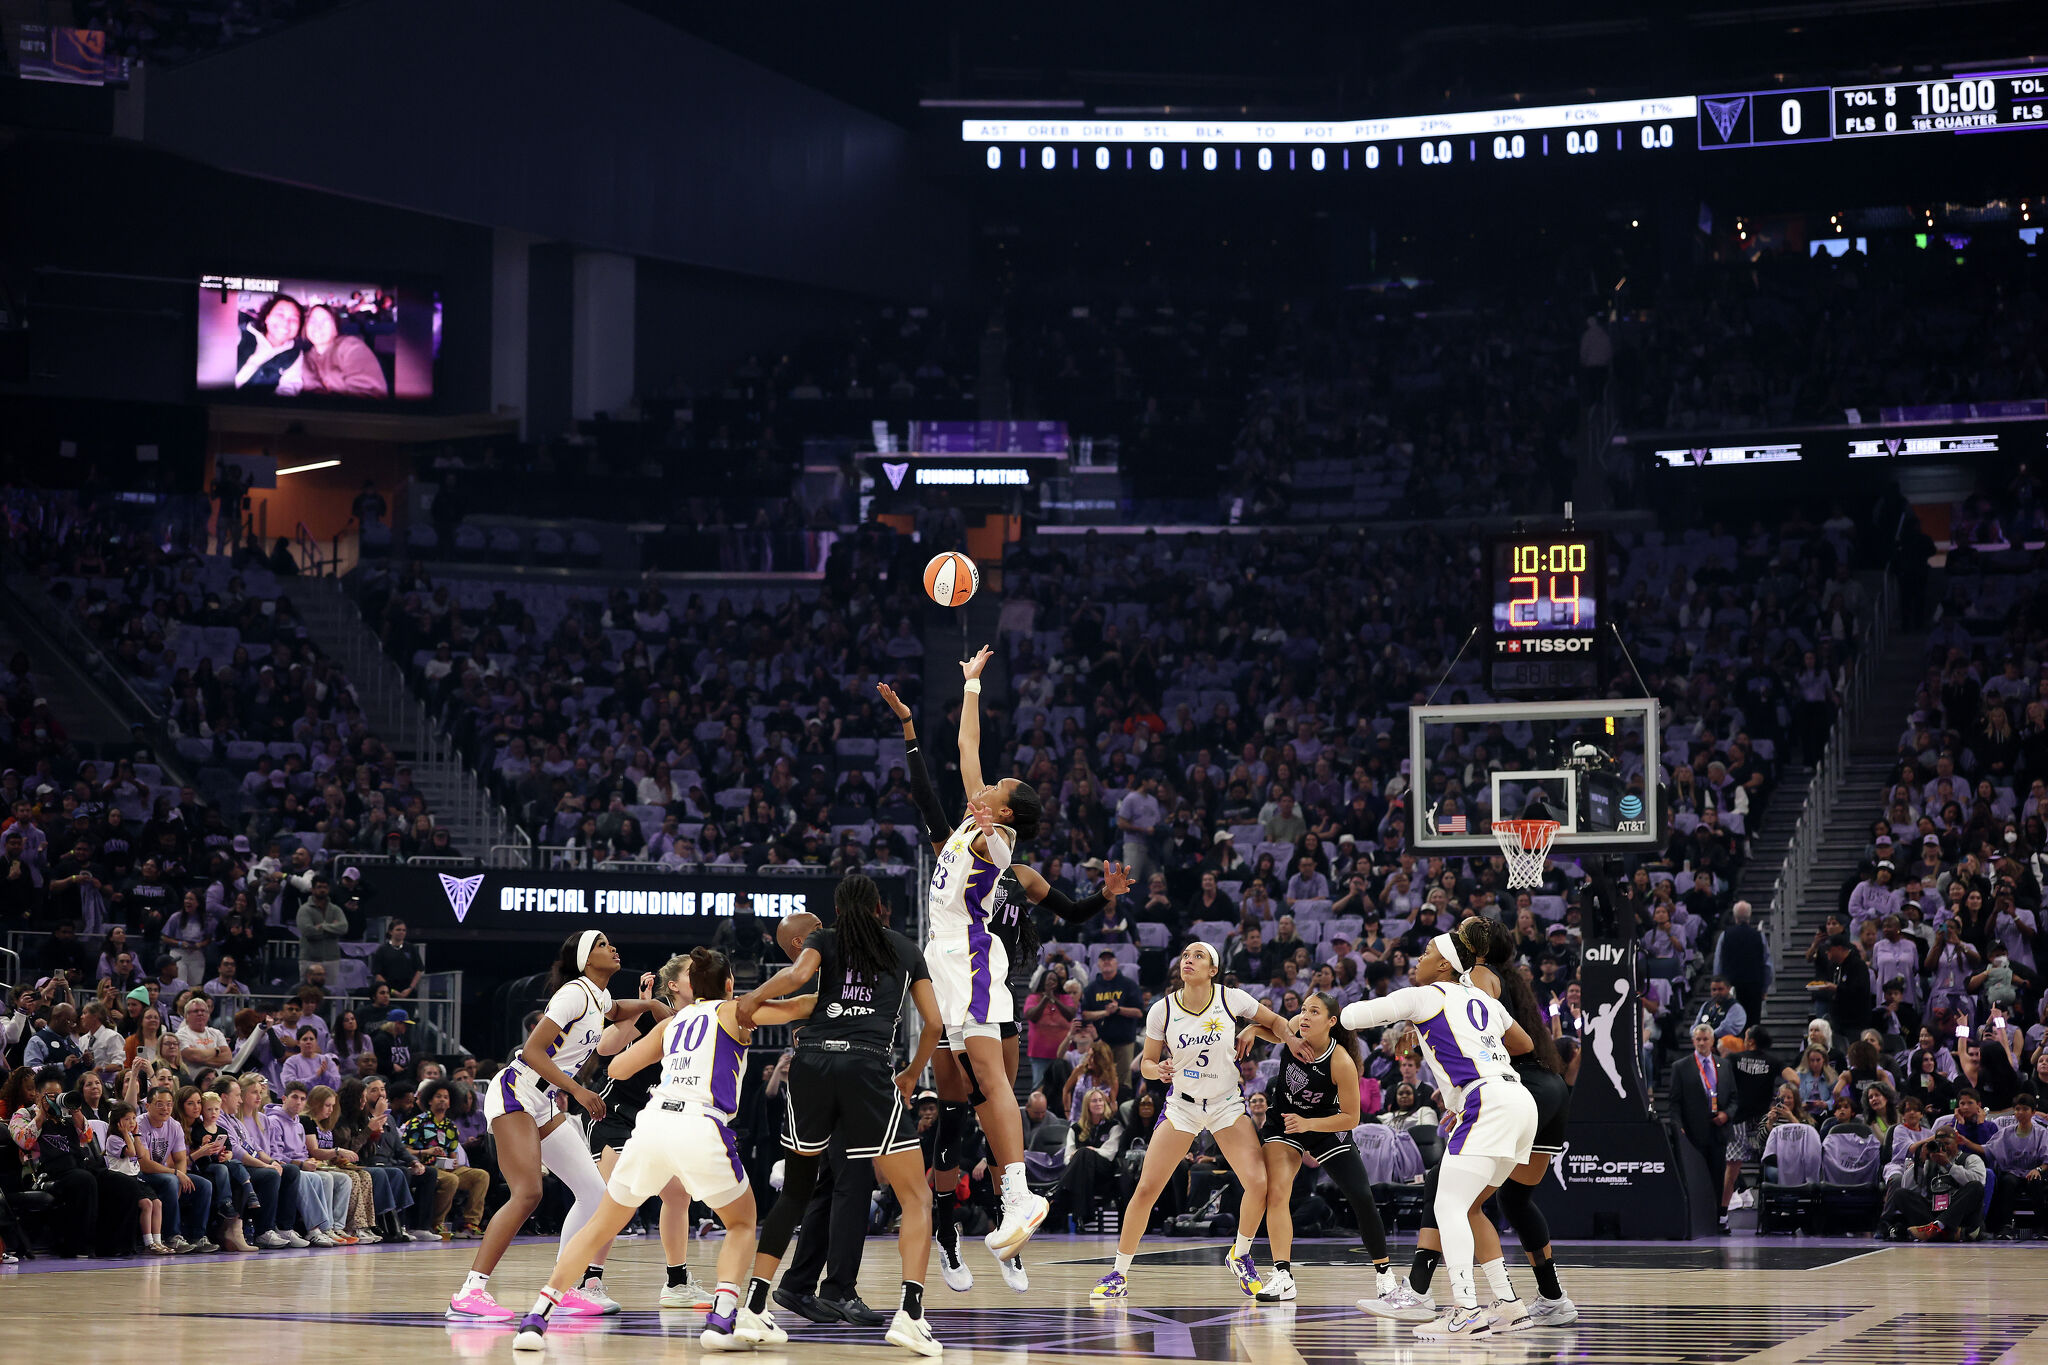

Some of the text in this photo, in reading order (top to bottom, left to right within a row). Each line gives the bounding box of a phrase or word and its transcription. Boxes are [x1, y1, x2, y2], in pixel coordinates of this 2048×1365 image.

[2011, 79, 2044, 94] TOL
[1844, 87, 1896, 106] TOL 5
[1917, 80, 1995, 114] 10:00
[1782, 98, 1801, 135] 0
[2013, 105, 2043, 120] FLS
[980, 126, 1008, 136] AST
[1144, 126, 1169, 137] STL
[1196, 127, 1224, 137] BLK
[1256, 127, 1275, 137] TO
[1305, 127, 1334, 137] POT
[1355, 124, 1389, 136] PITP
[1846, 112, 1896, 132] FLS 0
[1912, 114, 1997, 130] 1st QUARTER
[987, 124, 1673, 170] 0 0 0 0 0 0 0 0 0.0 0.0 0.0 0.0
[1514, 544, 1586, 574] 10:00
[1509, 575, 1580, 627] 24
[1523, 637, 1593, 653] TISSOT
[1617, 820, 1646, 832] AT&T
[932, 863, 948, 890] 23
[501, 886, 806, 917] OFFICIAL FOUNDING PANERS
[1002, 903, 1019, 927] 14
[1585, 943, 1625, 965] ally
[842, 984, 873, 1002] HAYES
[1096, 991, 1122, 1001] NAVY
[843, 1005, 876, 1017] AT&T
[1467, 998, 1488, 1031] 0
[665, 1014, 709, 1056] 10
[670, 1056, 691, 1070] PLUM
[1196, 1049, 1209, 1067] 5
[672, 1075, 700, 1085] AT&T
[1185, 1070, 1198, 1078] UCLA
[1302, 1089, 1324, 1103] 22
